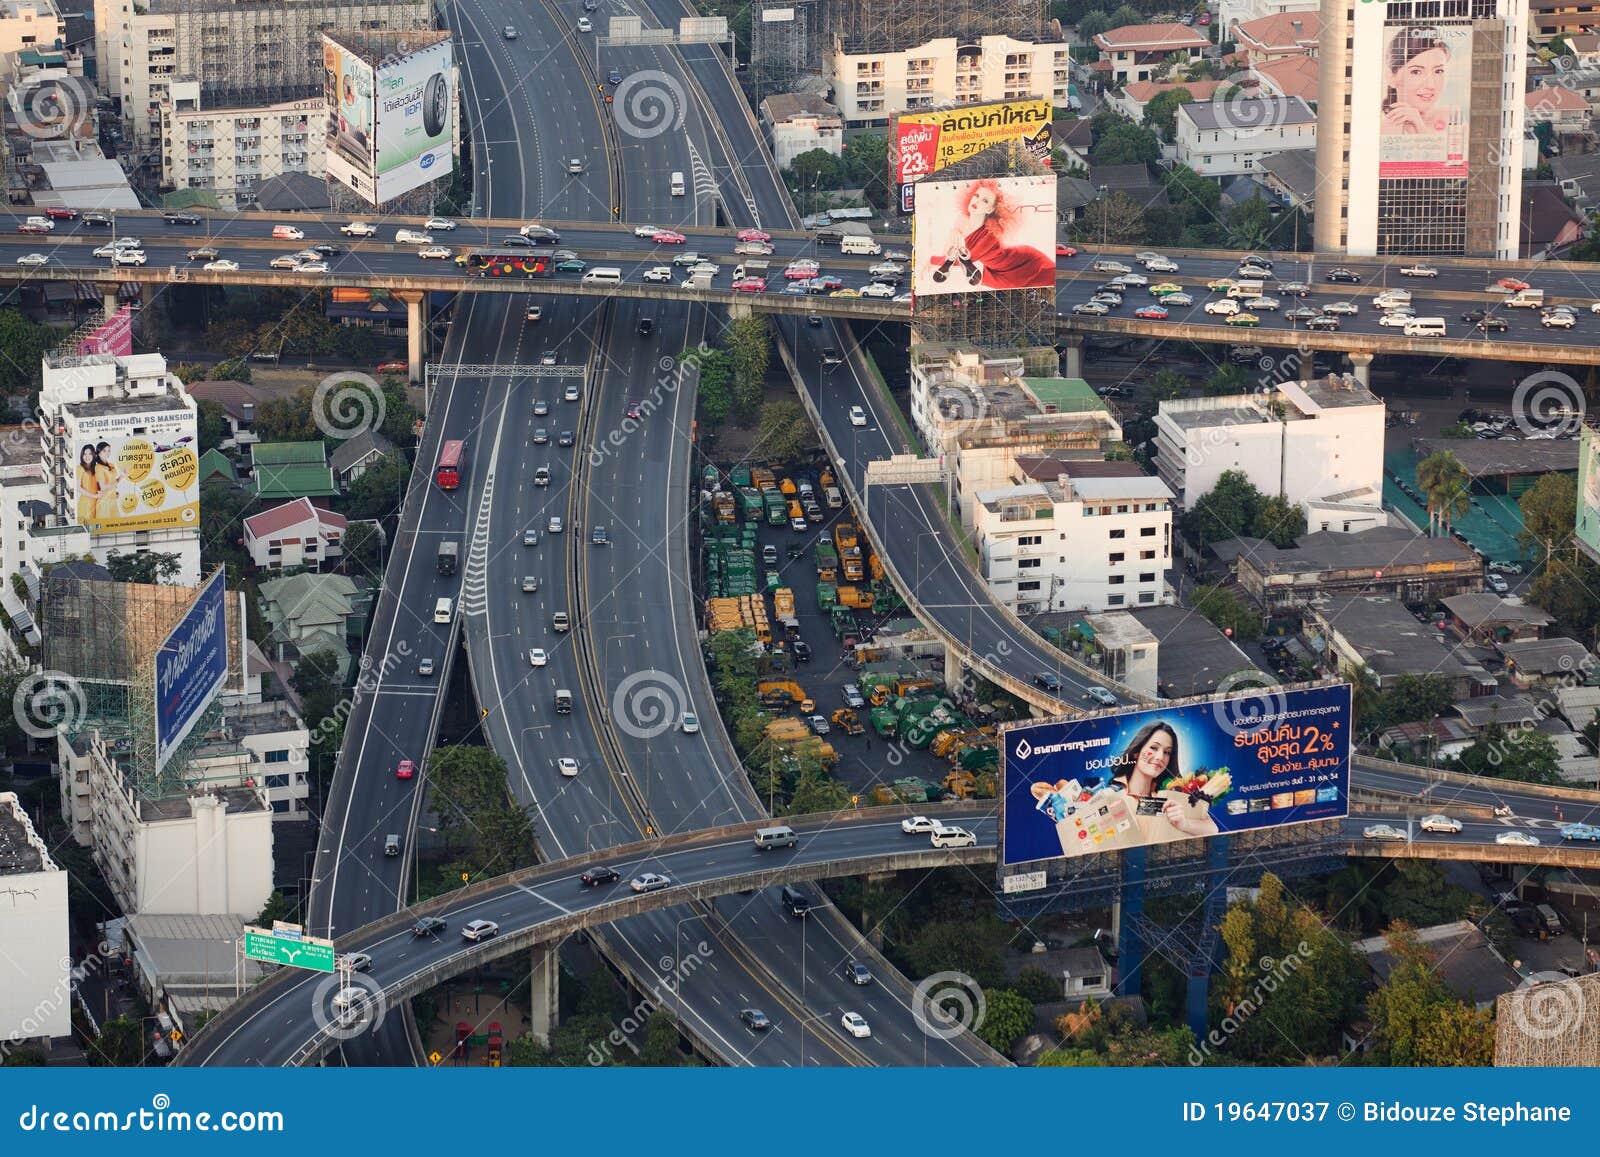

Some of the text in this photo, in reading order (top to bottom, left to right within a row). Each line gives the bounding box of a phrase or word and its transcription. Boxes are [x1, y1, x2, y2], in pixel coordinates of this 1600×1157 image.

[157, 413, 194, 423] MANSION
[1033, 737, 1110, 755] ธนาคารกรุงเทพ
[1234, 724, 1301, 748] รับเงินคืน
[1257, 741, 1300, 763] สูงสุด
